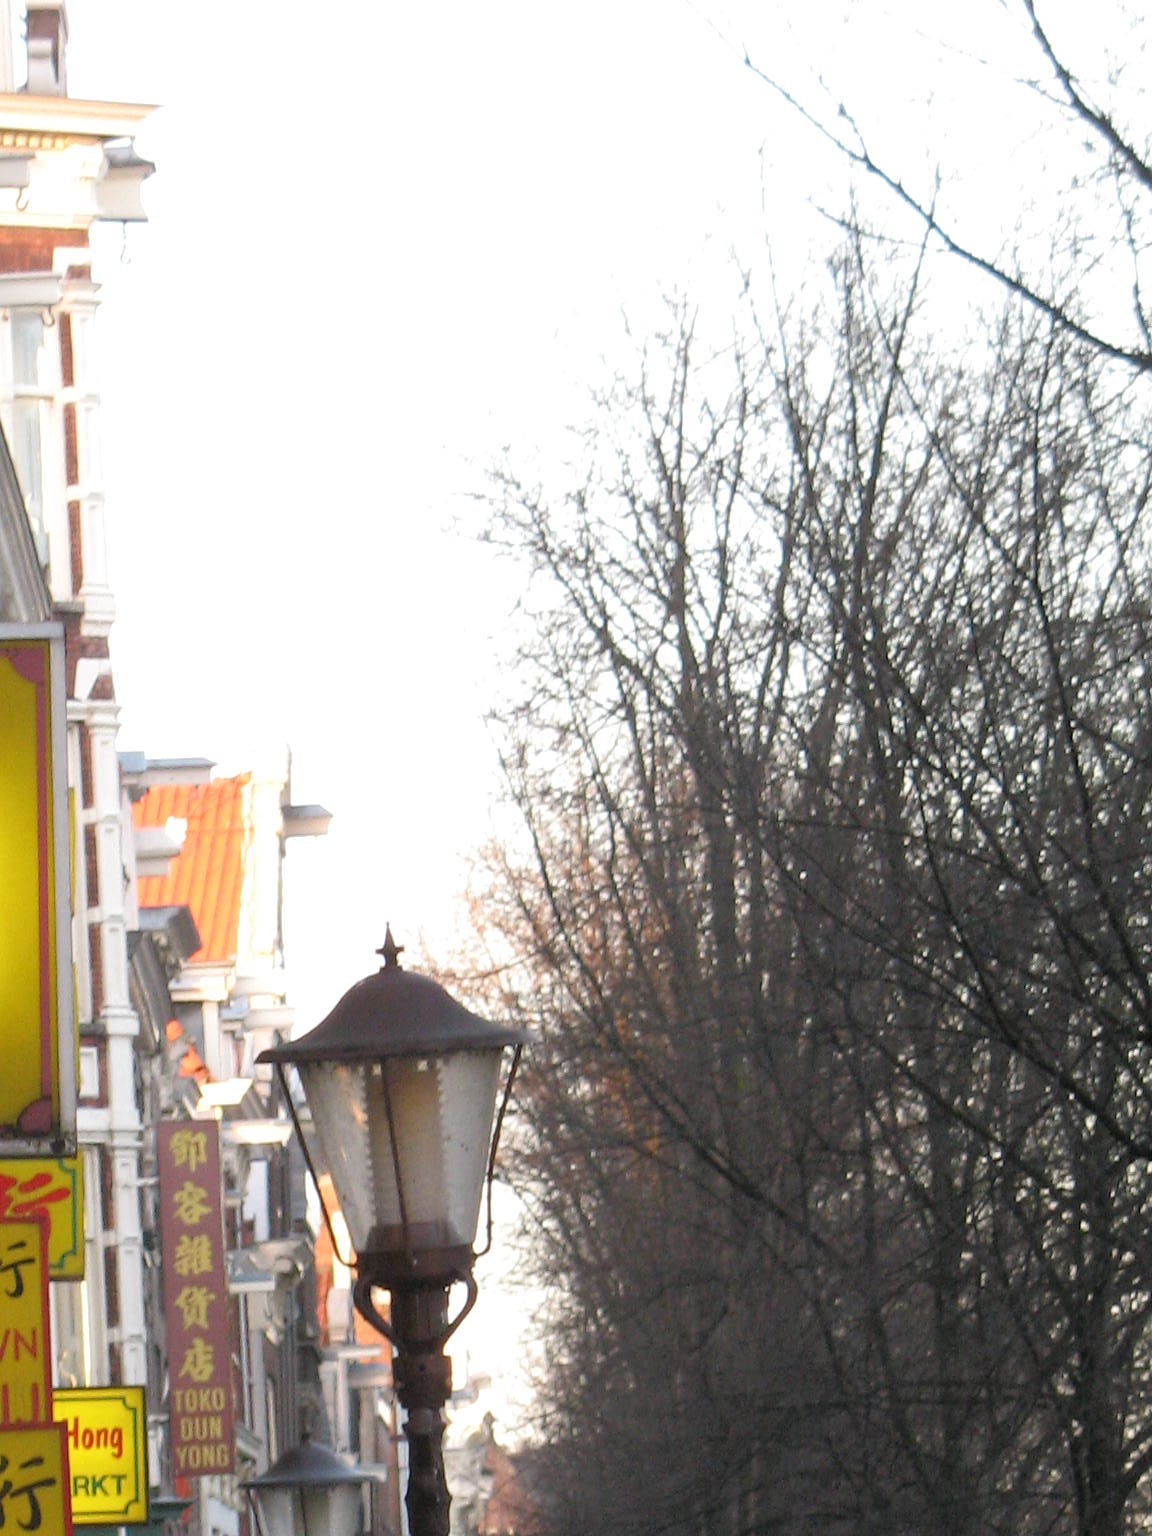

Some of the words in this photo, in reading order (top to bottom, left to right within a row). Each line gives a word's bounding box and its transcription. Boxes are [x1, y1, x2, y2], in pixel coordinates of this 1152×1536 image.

[174, 1388, 225, 1413] TOKO
[68, 1416, 123, 1459] Hong
[180, 1415, 223, 1441] DUN
[176, 1444, 230, 1469] YONG
